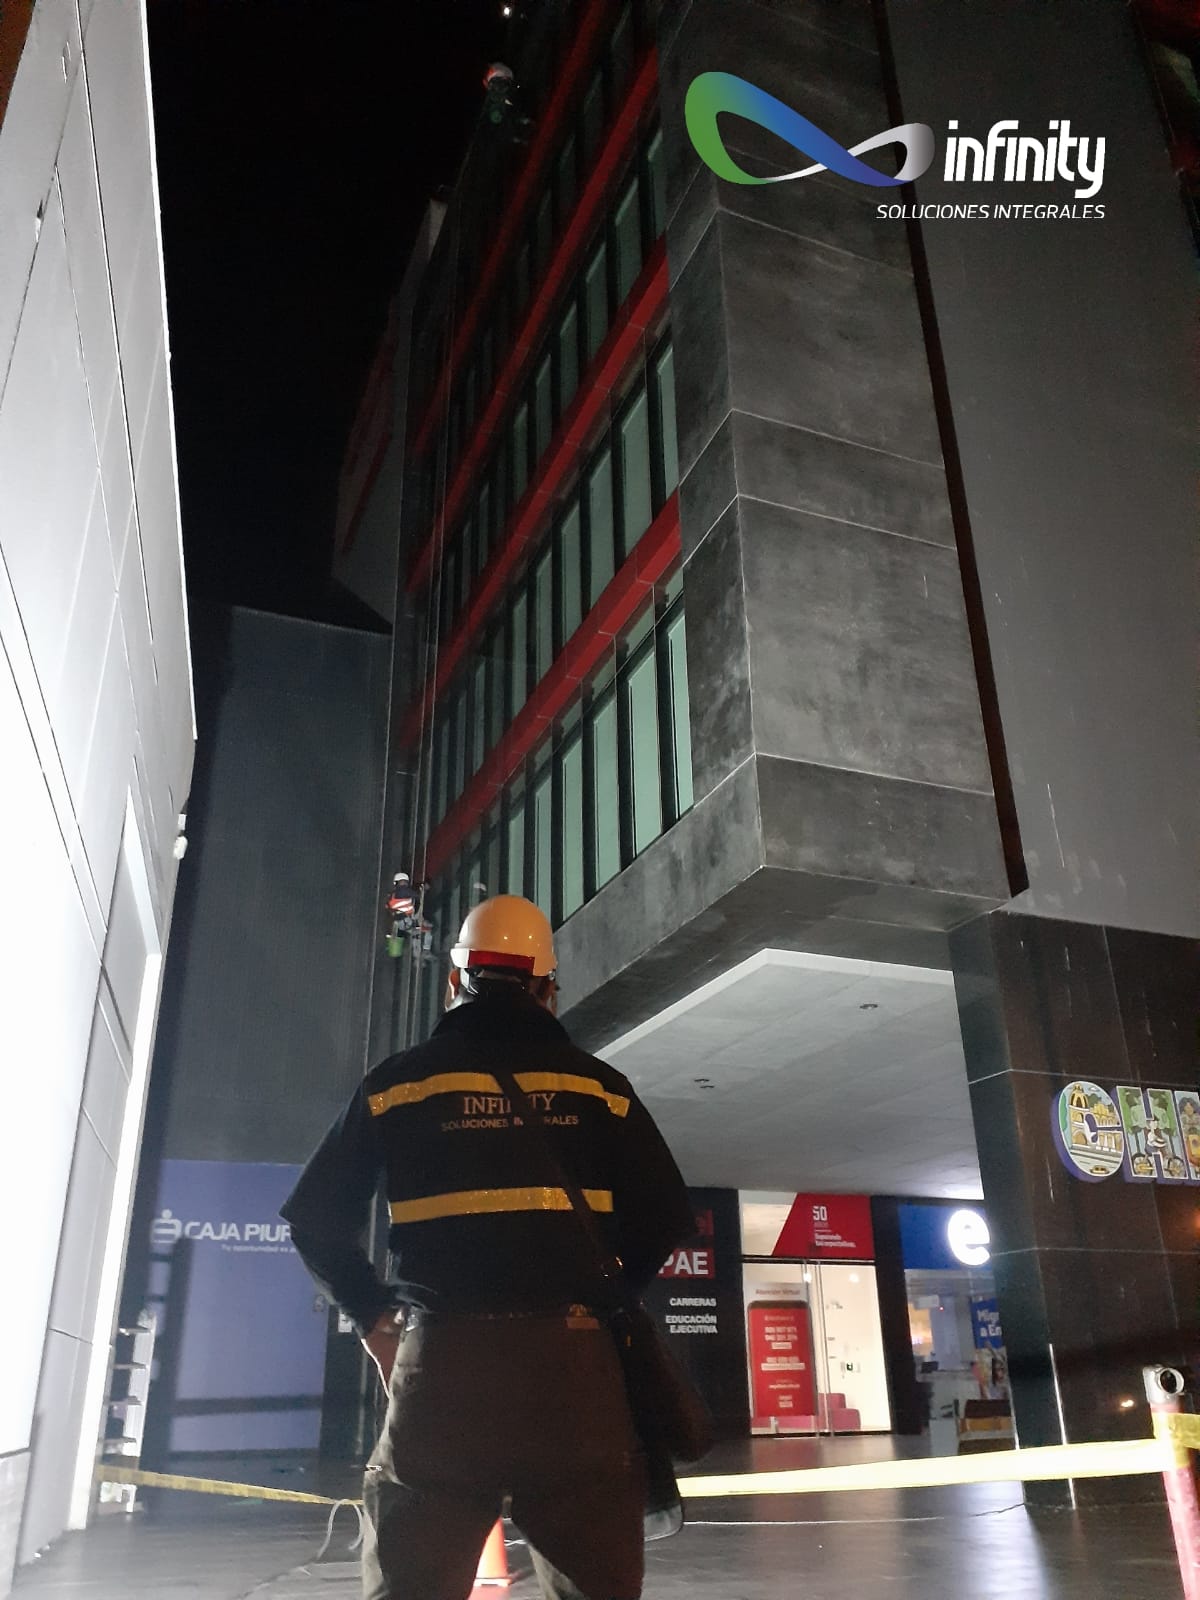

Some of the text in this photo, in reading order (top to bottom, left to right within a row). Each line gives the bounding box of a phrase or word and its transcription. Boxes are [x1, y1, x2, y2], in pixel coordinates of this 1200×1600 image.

[441, 1118, 509, 1132] SOLUCIONES
[812, 1205, 828, 1221] 50
[184, 1221, 241, 1241] CAJA
[947, 1209, 991, 1266] e
[669, 1297, 717, 1307] CARRERAS
[665, 1313, 717, 1324] EDUCACIÓN
[670, 1324, 718, 1334] EJECUTIVA
